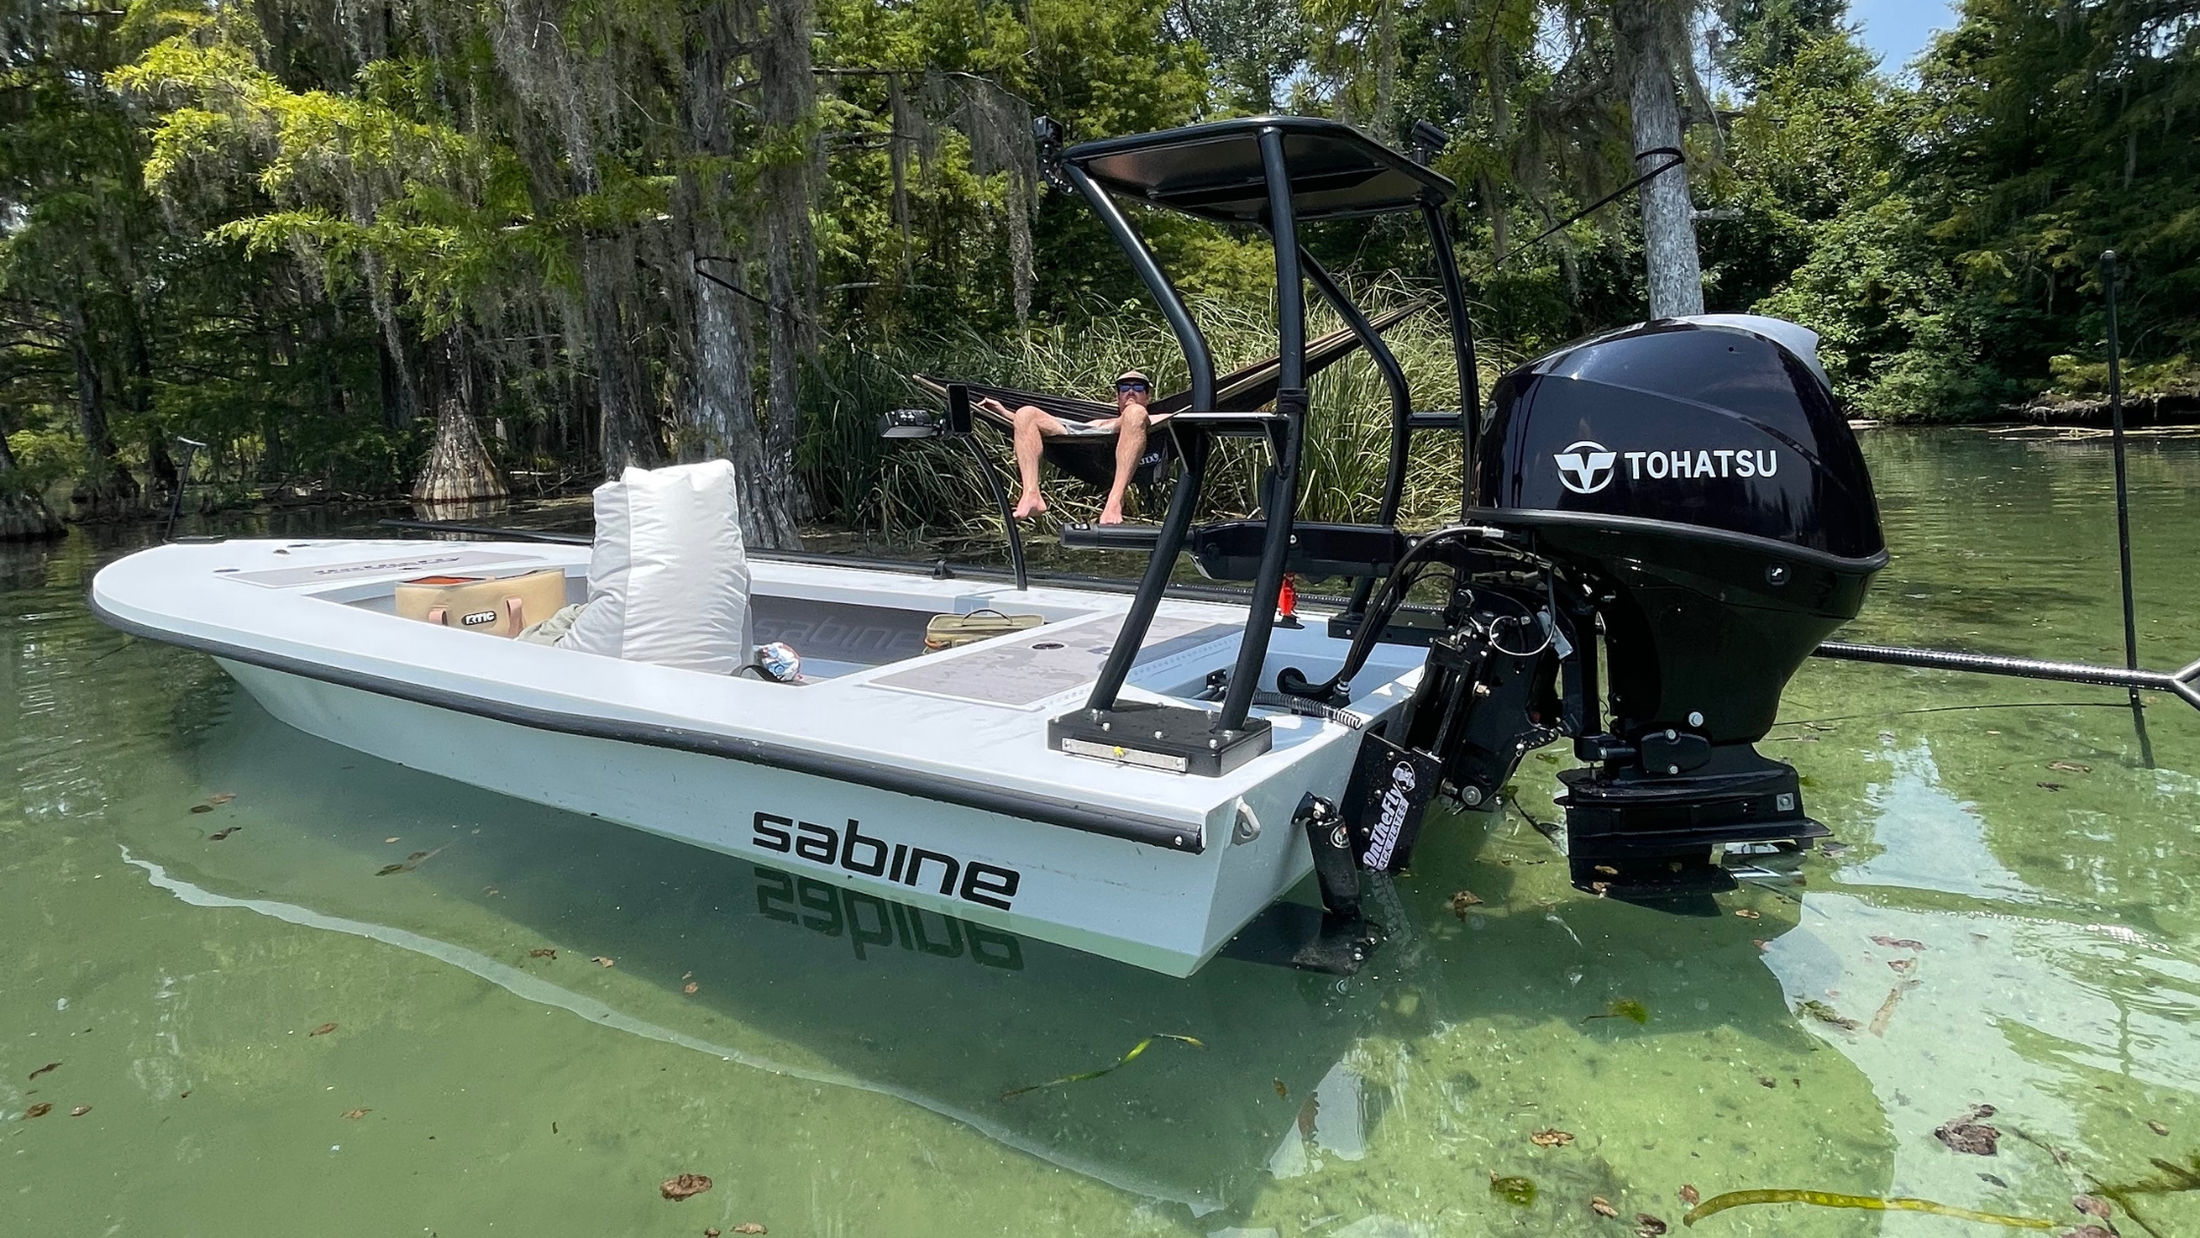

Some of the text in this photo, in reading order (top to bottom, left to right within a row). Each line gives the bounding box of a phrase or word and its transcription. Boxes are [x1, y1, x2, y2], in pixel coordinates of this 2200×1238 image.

[1624, 450, 1778, 480] TOHATSU
[465, 611, 495, 625] RTIC
[753, 811, 1021, 911] sabine
